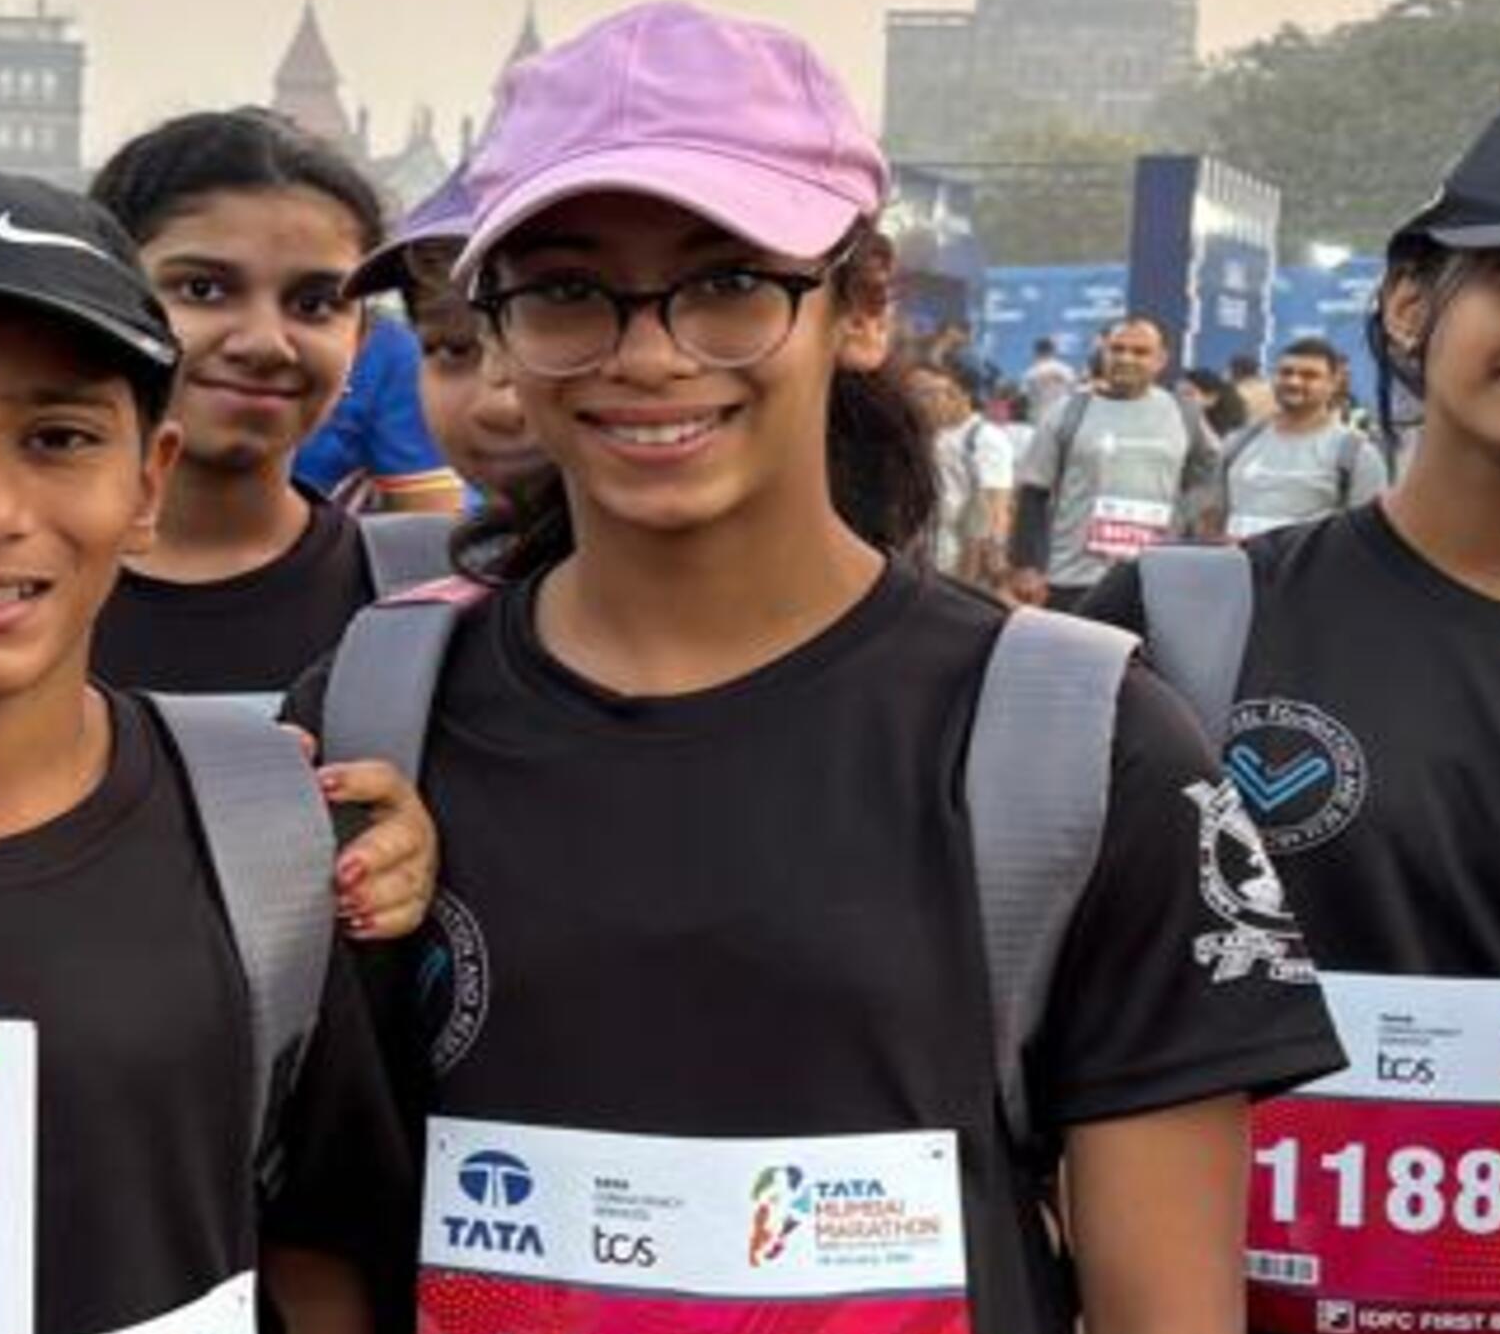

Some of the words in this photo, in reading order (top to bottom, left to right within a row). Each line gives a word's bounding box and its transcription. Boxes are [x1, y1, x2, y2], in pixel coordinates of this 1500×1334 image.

[1376, 1051, 1436, 1085] tcs
[815, 1178, 887, 1199] TATA
[441, 1215, 545, 1258] TATA
[593, 1224, 657, 1268] tcs
[1358, 1311, 1416, 1330] IDFC
[1419, 1312, 1484, 1331] FIRST
